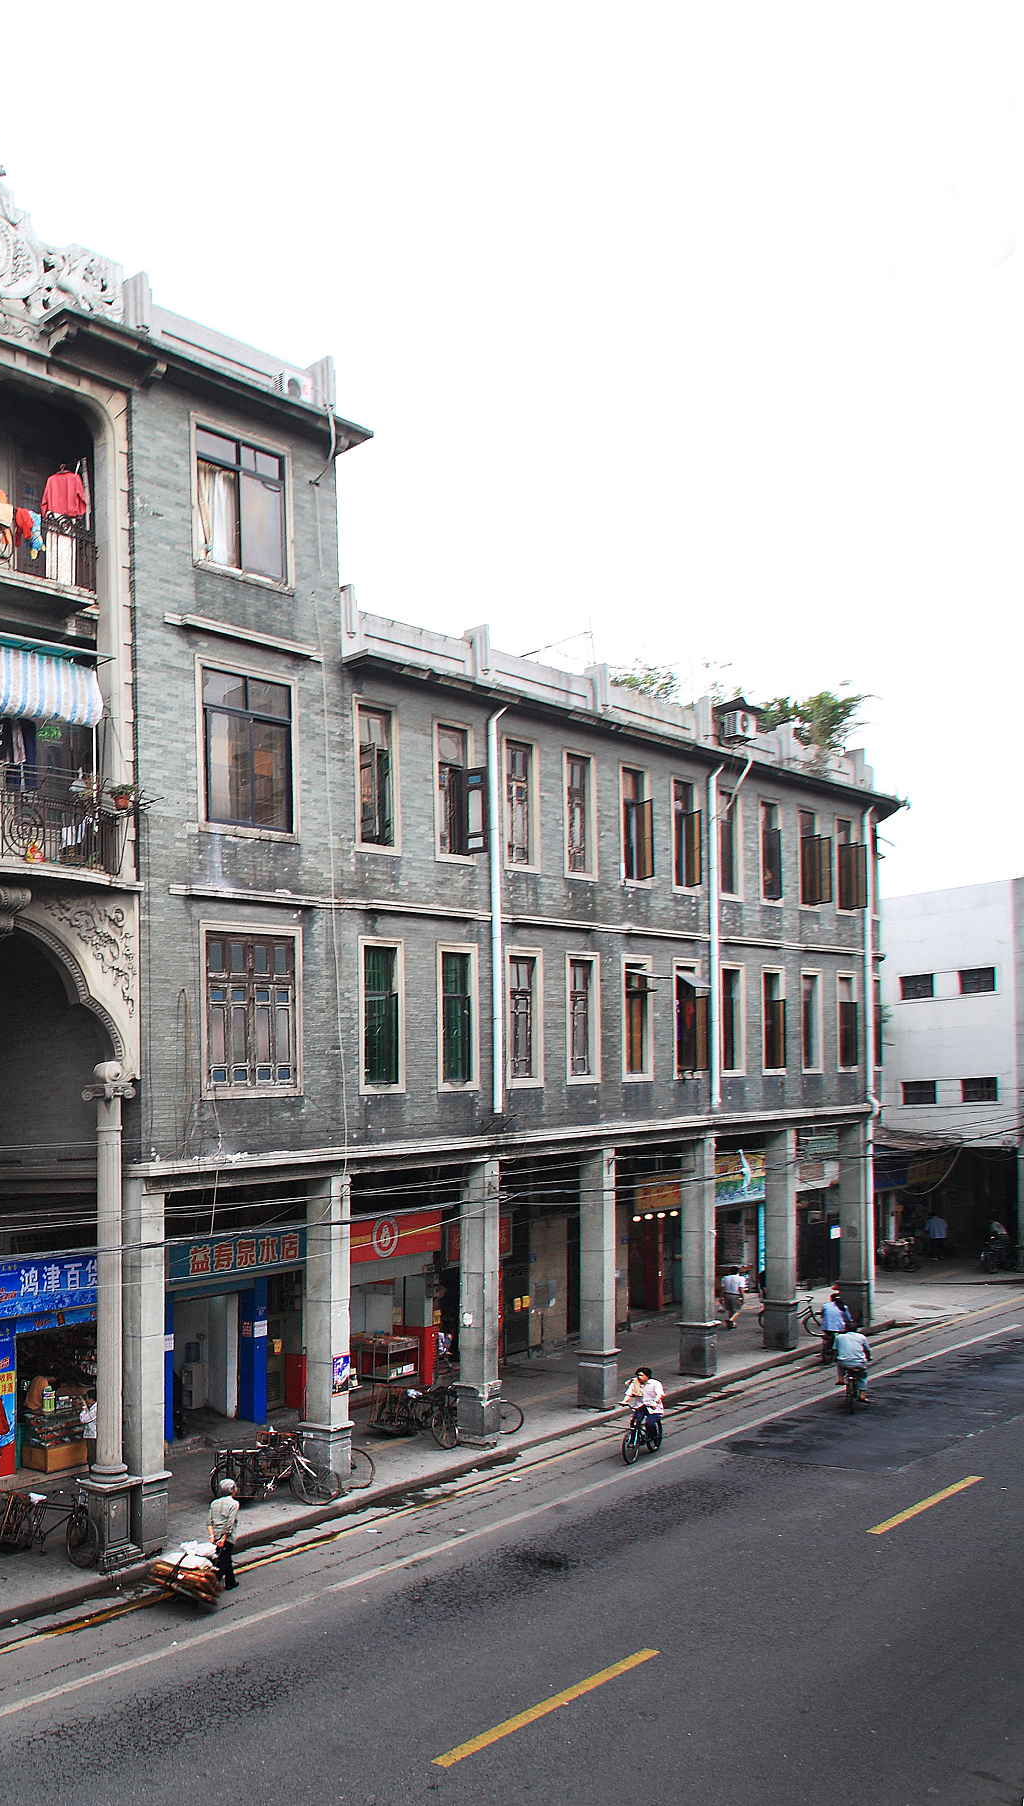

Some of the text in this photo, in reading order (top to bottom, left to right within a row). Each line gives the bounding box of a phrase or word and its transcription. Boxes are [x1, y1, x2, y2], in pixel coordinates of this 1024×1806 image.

[190, 1233, 299, 1275] 益寿泉水店
[20, 1260, 97, 1296] 鸿津百货
